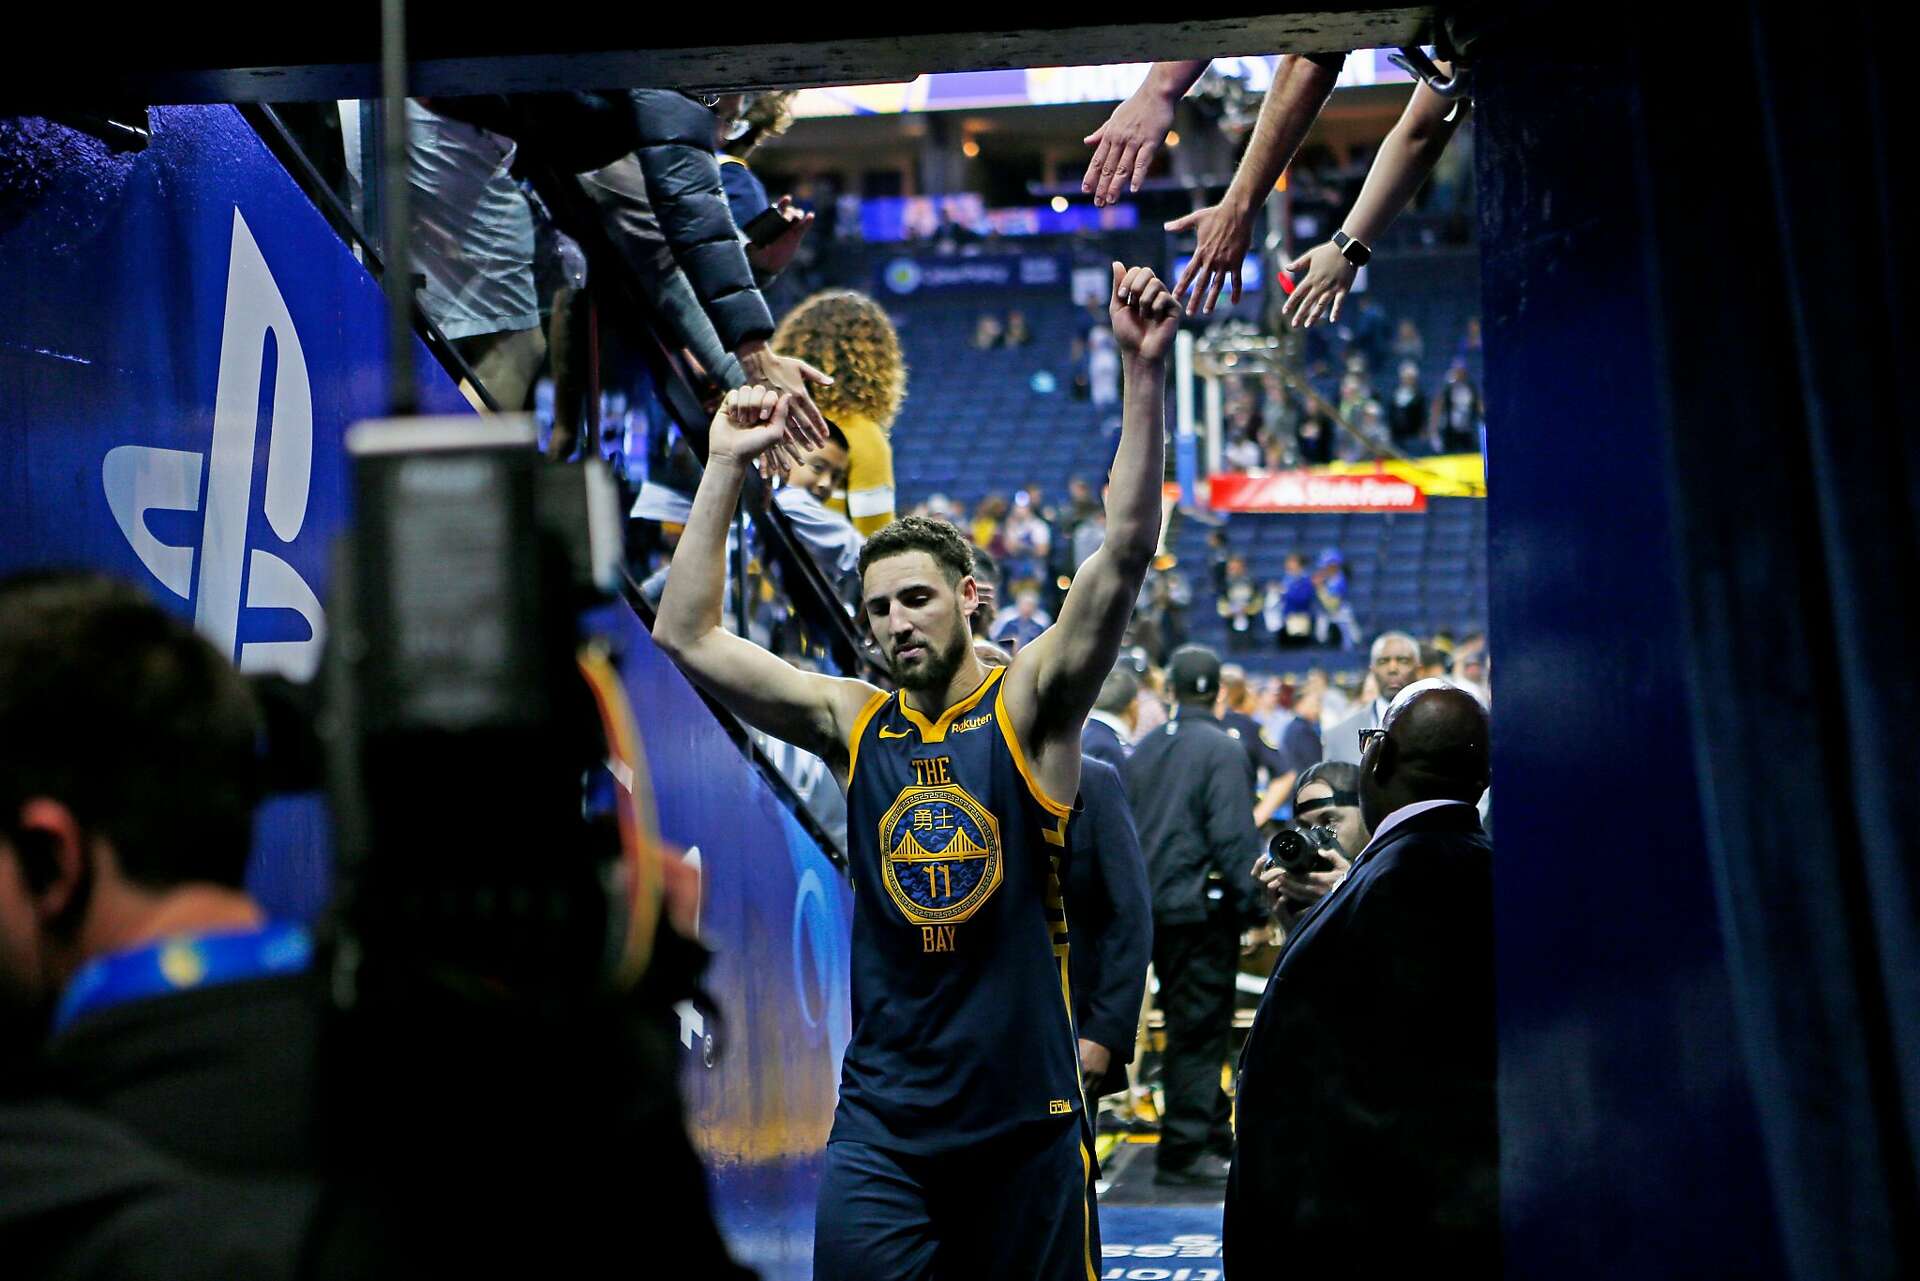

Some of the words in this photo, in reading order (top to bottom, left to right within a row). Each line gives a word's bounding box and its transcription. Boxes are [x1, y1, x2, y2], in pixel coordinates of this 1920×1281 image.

[911, 756, 952, 786] THE
[913, 808, 954, 831] 勇士
[922, 864, 951, 898] 11
[921, 925, 956, 953] BAY
